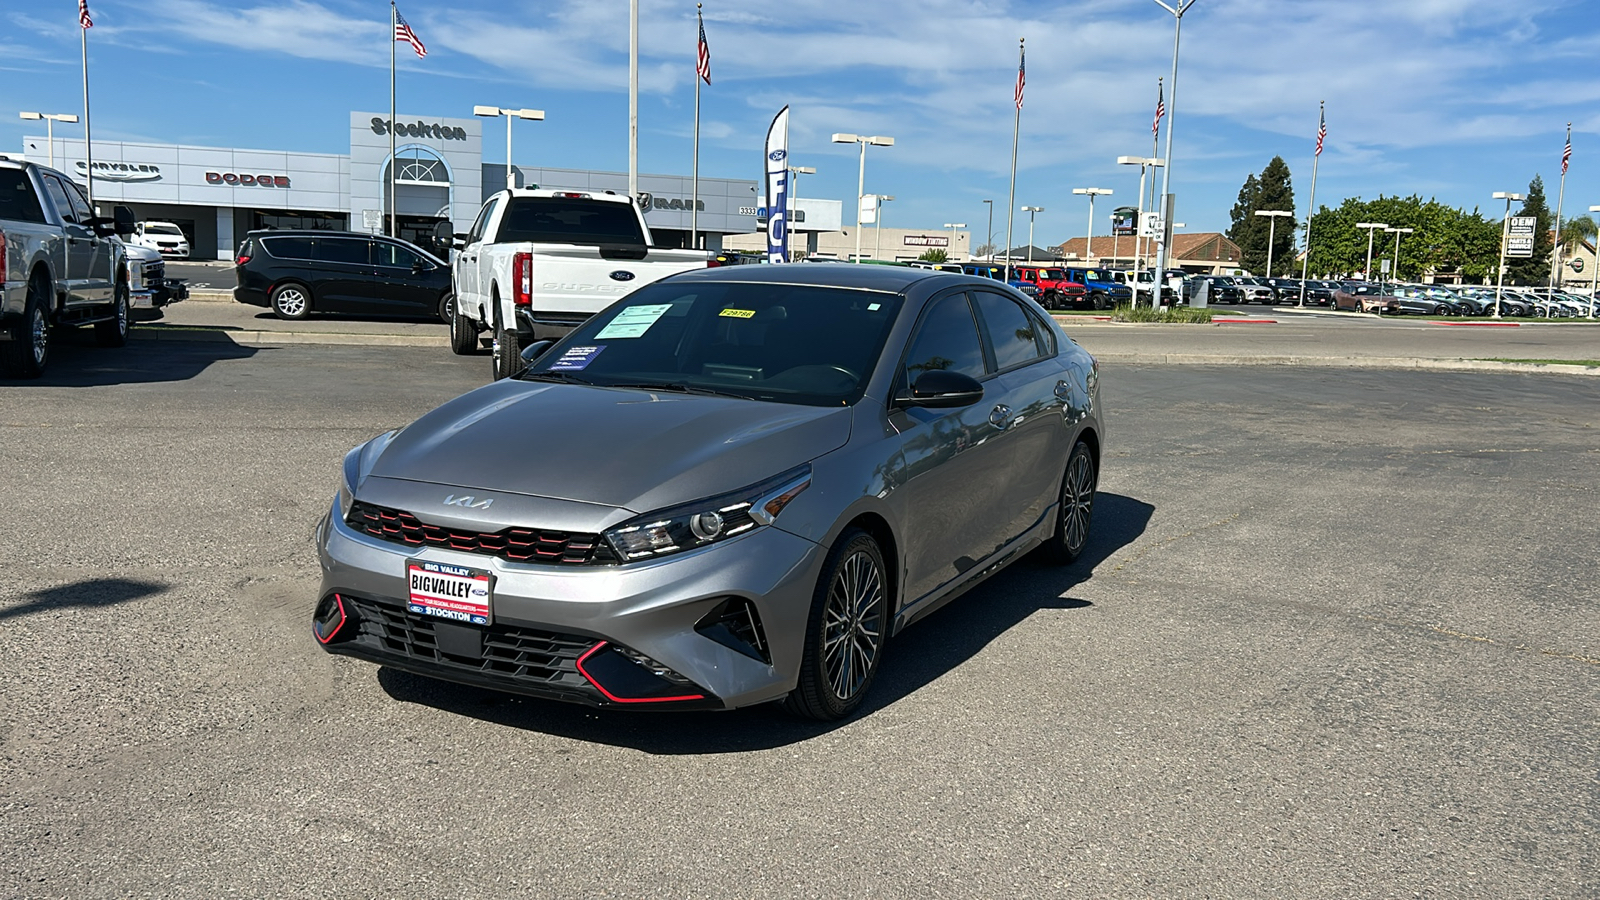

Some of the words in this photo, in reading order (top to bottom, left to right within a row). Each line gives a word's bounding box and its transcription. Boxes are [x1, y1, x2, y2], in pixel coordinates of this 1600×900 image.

[371, 117, 466, 141] Stockton
[76, 161, 160, 173] CHRYSLER
[205, 172, 291, 188] DODGE
[653, 197, 705, 211] RAM
[740, 207, 756, 215] 3333
[1511, 218, 1533, 226] OEM
[905, 237, 927, 245] WINDOW
[928, 237, 948, 245] TINTING
[542, 282, 629, 293] SUPER
[443, 494, 494, 509] KIA
[424, 563, 439, 571] BIG
[440, 565, 470, 576] VALLEY
[411, 574, 472, 598] BIGVALLEY
[425, 606, 471, 621] STOCKTON
